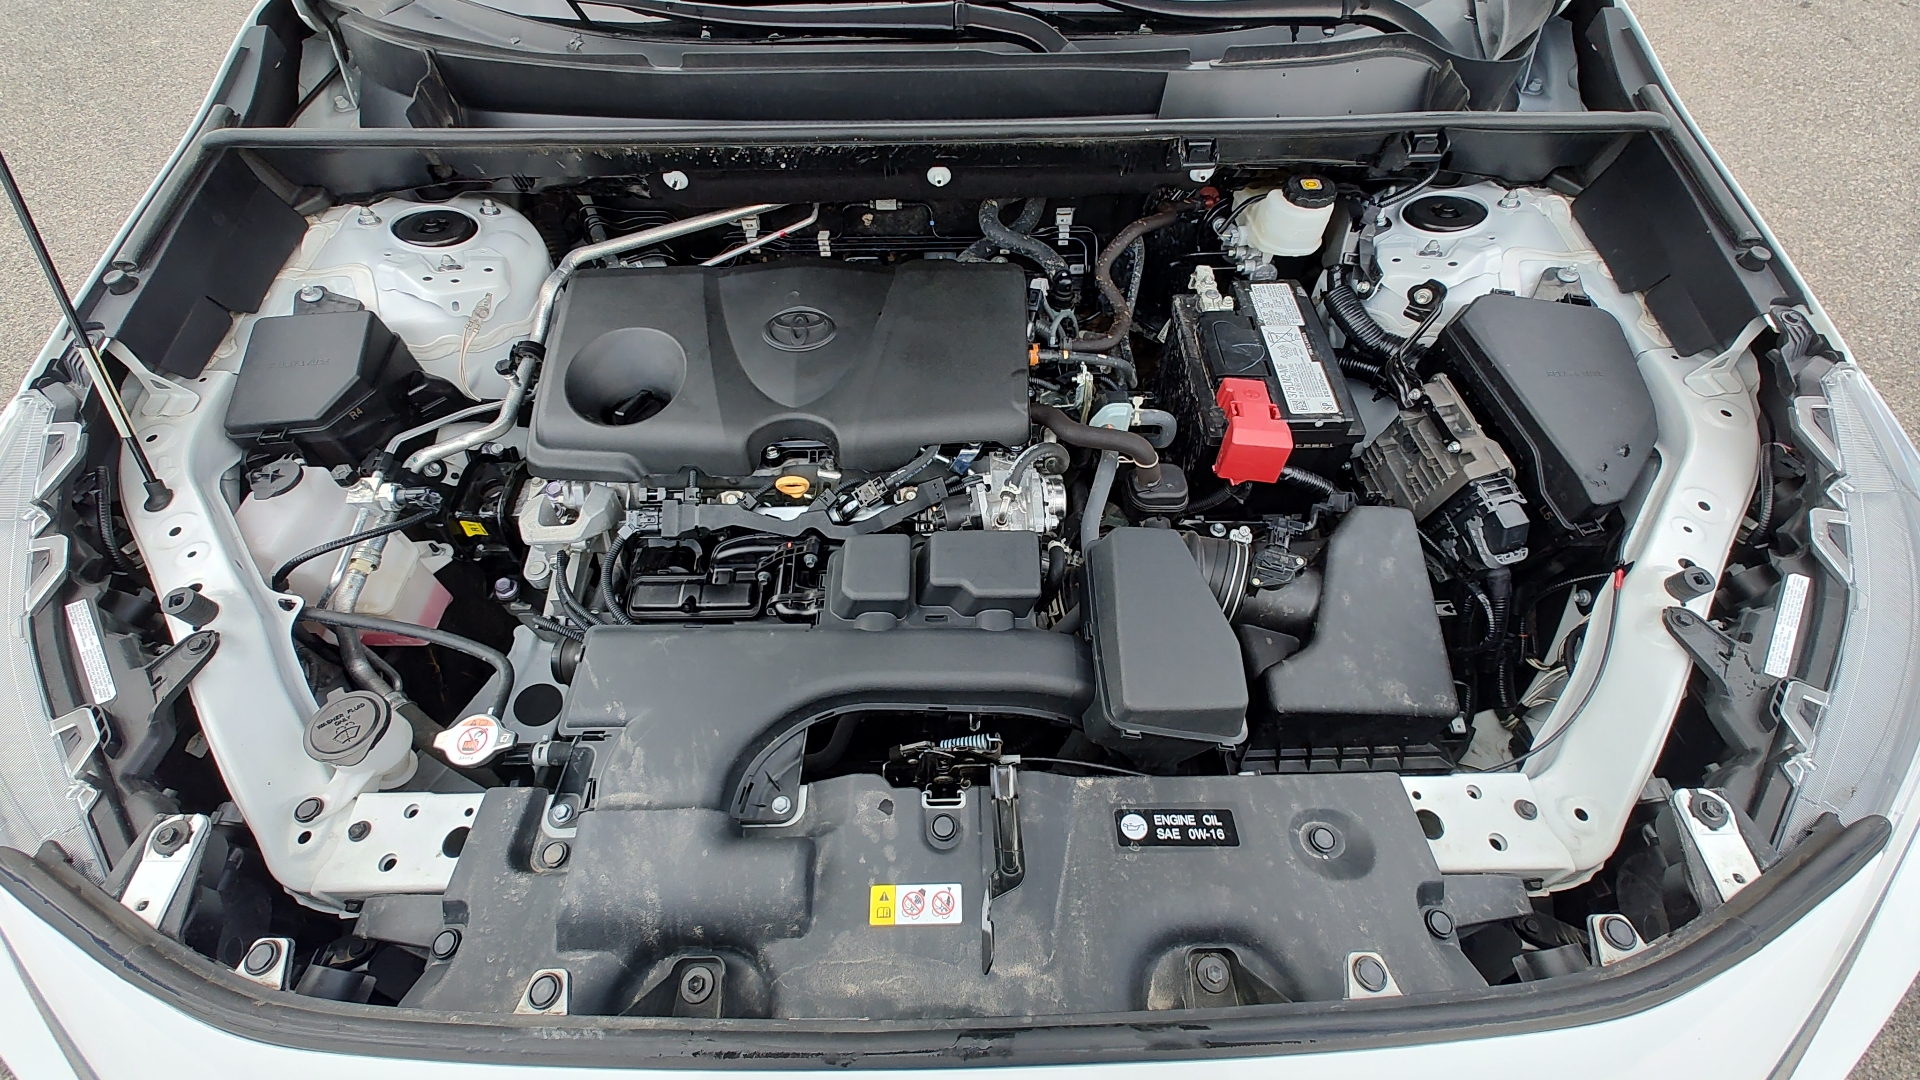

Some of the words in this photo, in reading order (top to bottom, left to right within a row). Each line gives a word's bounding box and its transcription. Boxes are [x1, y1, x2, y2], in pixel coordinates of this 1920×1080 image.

[349, 407, 363, 420] R4
[1539, 504, 1554, 520] L5
[316, 713, 344, 730] WASHER
[347, 702, 366, 714] FLUID
[334, 715, 351, 726] ONLY
[1153, 814, 1197, 826] ENGINE
[1202, 814, 1223, 826] OIL
[1156, 827, 1181, 840] SAE
[1188, 828, 1225, 840] 0W-16
